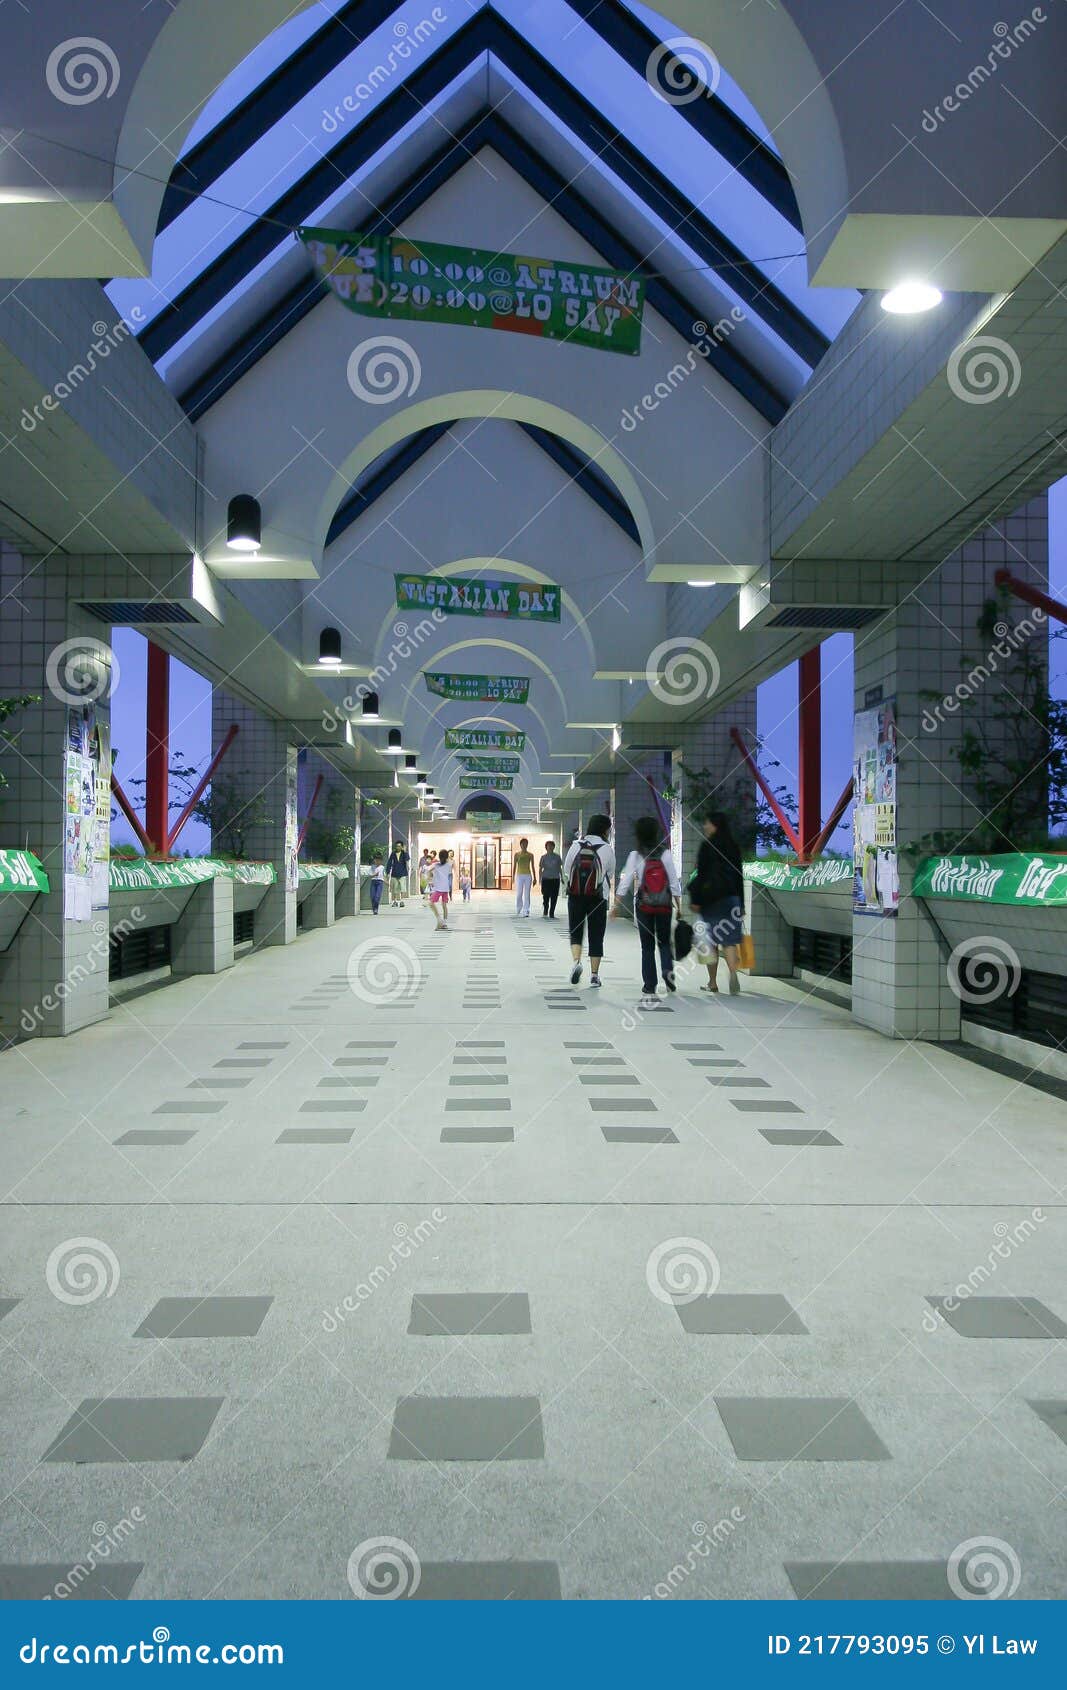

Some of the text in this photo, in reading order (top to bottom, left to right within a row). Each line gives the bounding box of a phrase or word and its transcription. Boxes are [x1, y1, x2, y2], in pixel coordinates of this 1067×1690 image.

[565, 298, 620, 336] SAY
[402, 582, 556, 612] VISTALIAN DAY
[1015, 857, 1067, 899] Day
